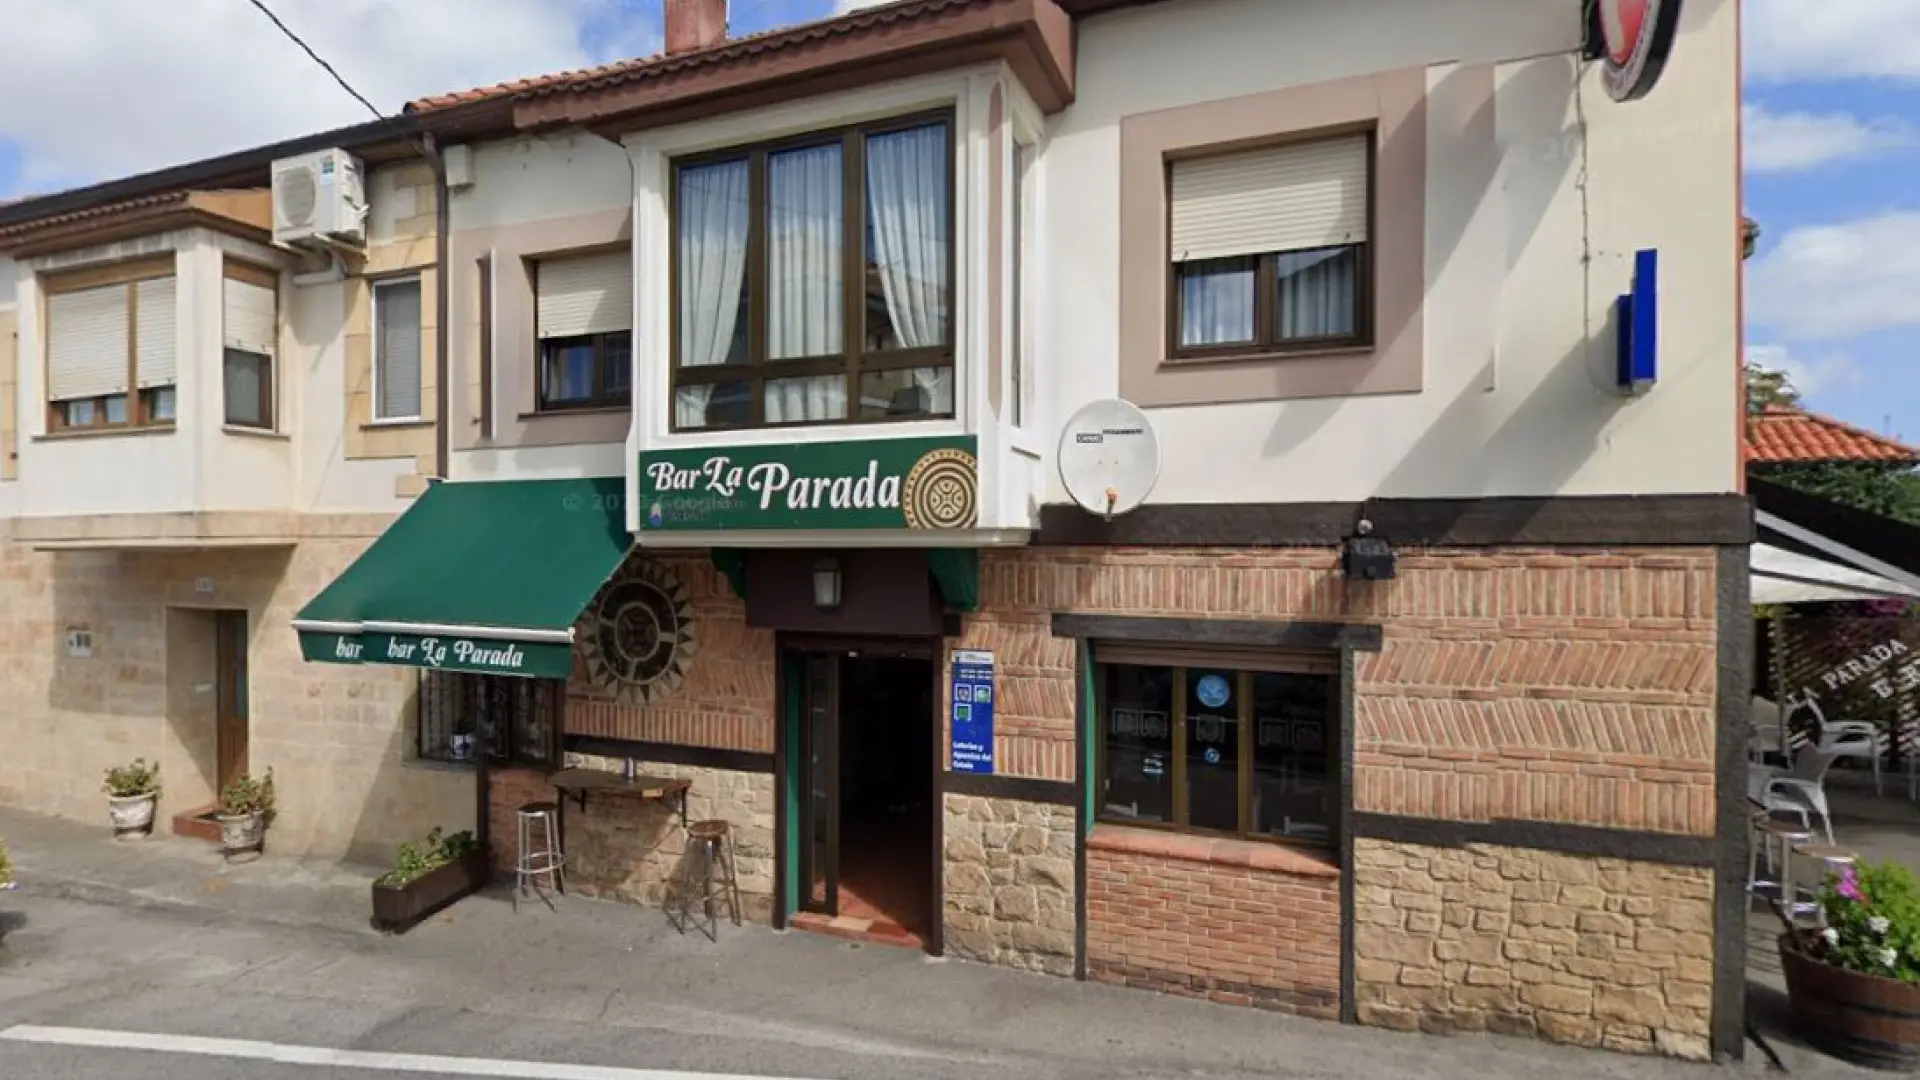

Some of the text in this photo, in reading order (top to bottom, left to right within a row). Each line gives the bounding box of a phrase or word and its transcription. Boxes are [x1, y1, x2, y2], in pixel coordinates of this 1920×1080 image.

[647, 456, 901, 510] Bar La Parada
[335, 636, 363, 657] bar
[387, 636, 524, 668] bar La Parada
[1820, 638, 1908, 690] PARADA
